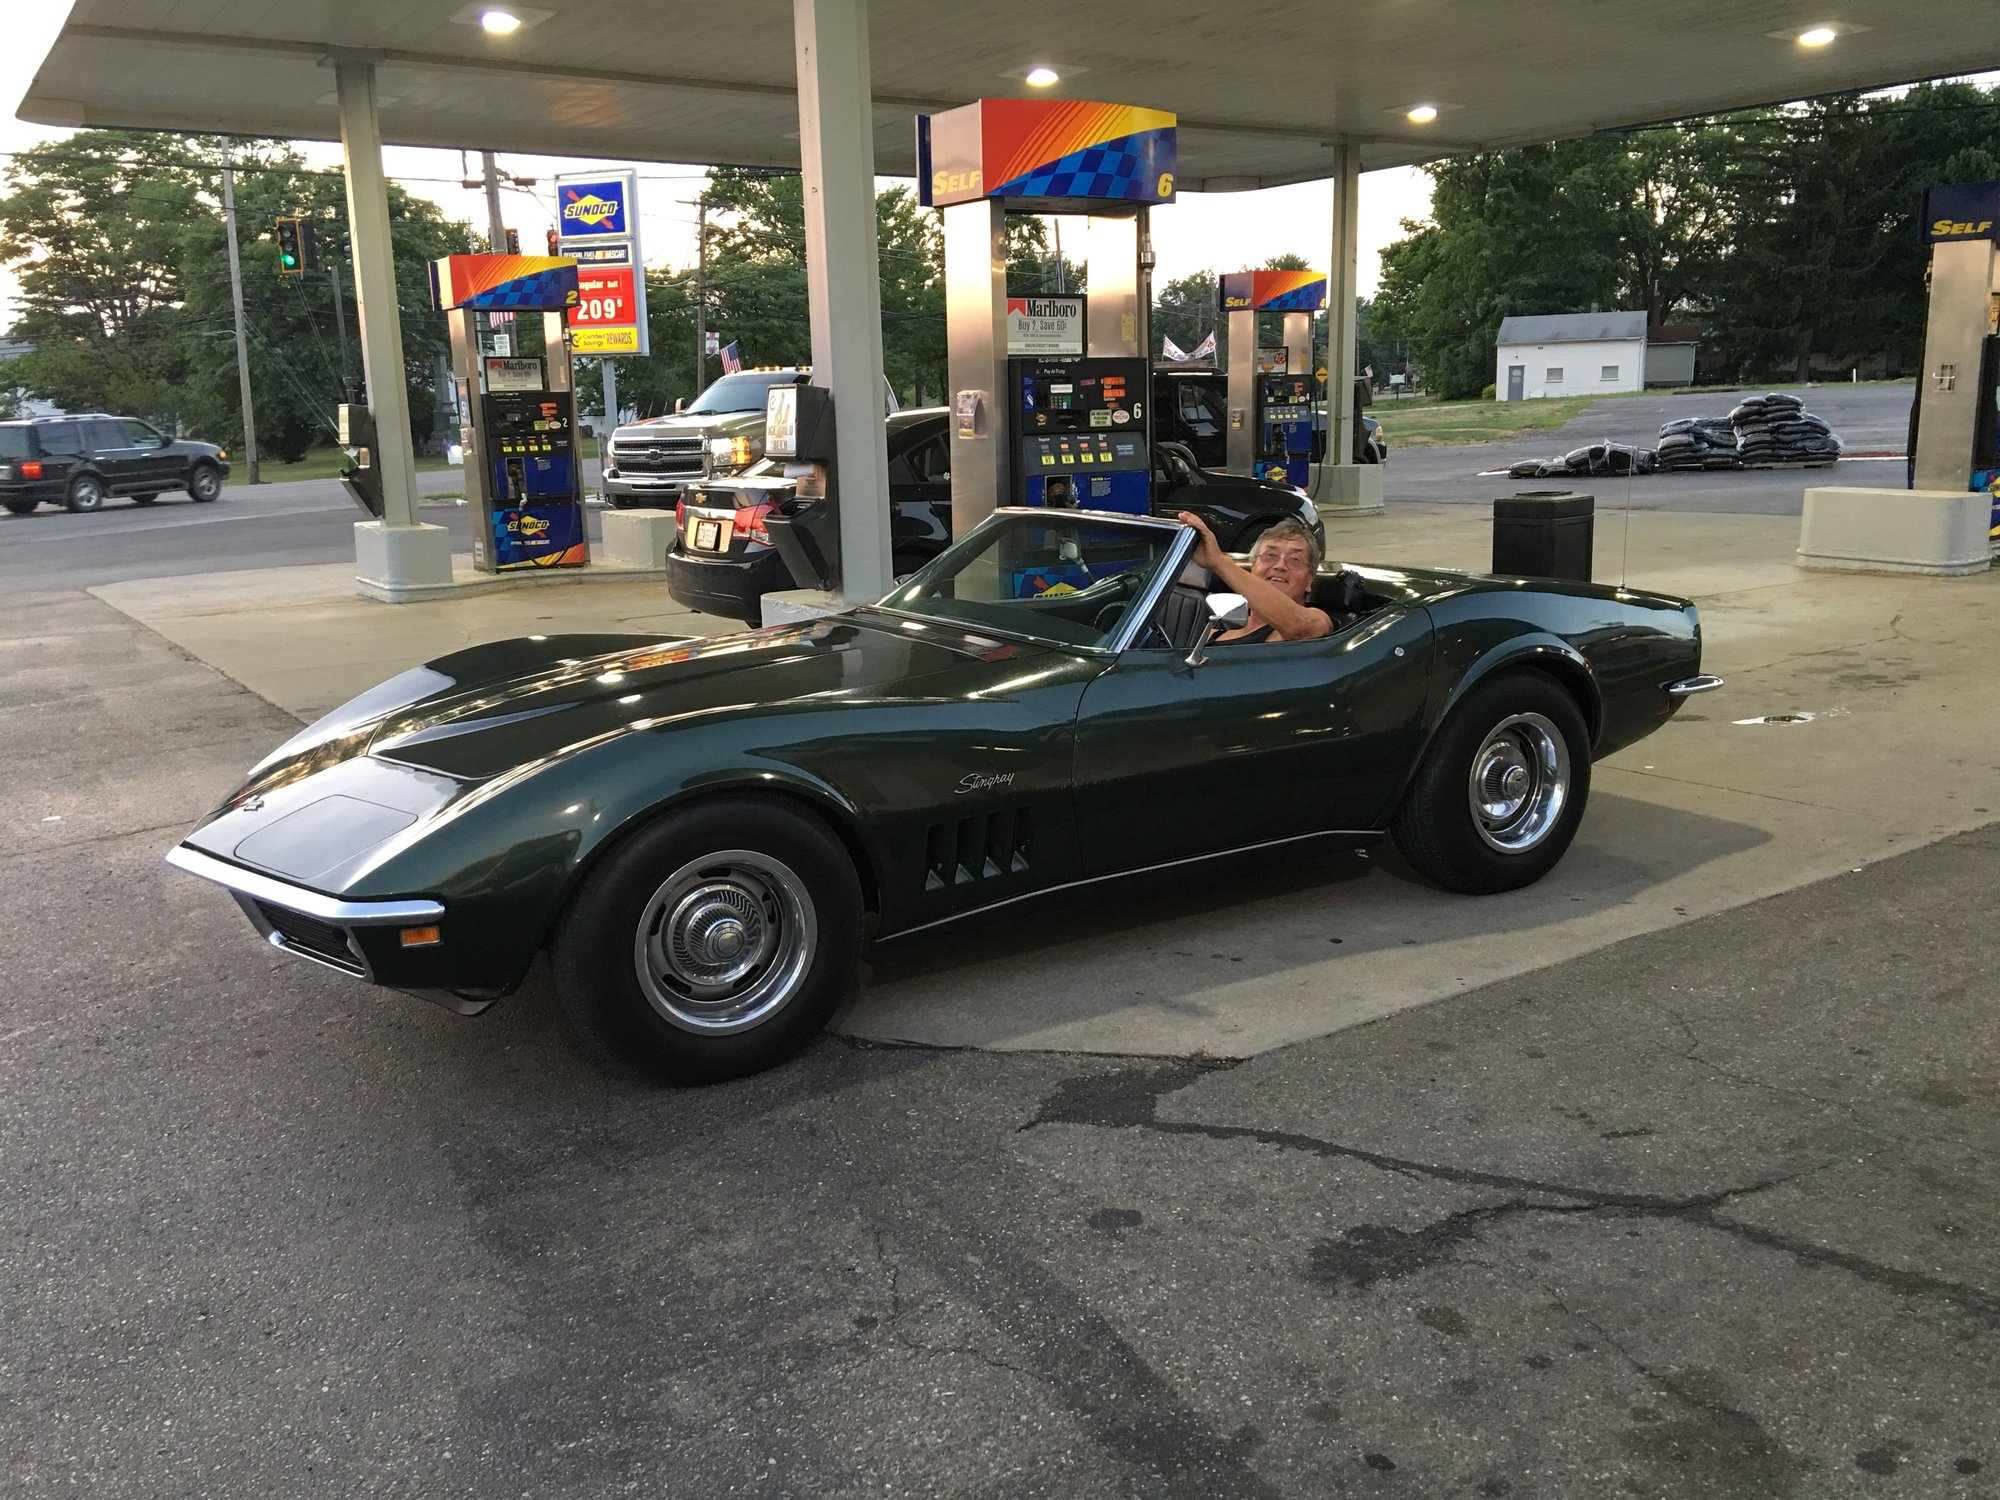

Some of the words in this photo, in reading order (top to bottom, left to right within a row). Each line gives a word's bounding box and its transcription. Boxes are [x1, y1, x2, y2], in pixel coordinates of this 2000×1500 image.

[932, 170, 982, 196] SELF
[1157, 173, 1174, 198] 6
[566, 202, 617, 217] SUNOCO
[1930, 219, 1993, 236] SELF
[578, 280, 604, 291] egular
[565, 290, 578, 304] 2
[1225, 297, 1251, 308] SELF
[1319, 298, 1326, 309] 4
[577, 298, 616, 320] 209
[1026, 299, 1077, 318] Marlboro
[1018, 320, 1031, 334] Buy
[1040, 321, 1055, 331] Save
[606, 333, 633, 345] REWARDS
[503, 360, 538, 370] Marlboro
[1133, 402, 1142, 419] 6
[561, 417, 569, 428] 2
[953, 772, 1016, 794] Stingray
